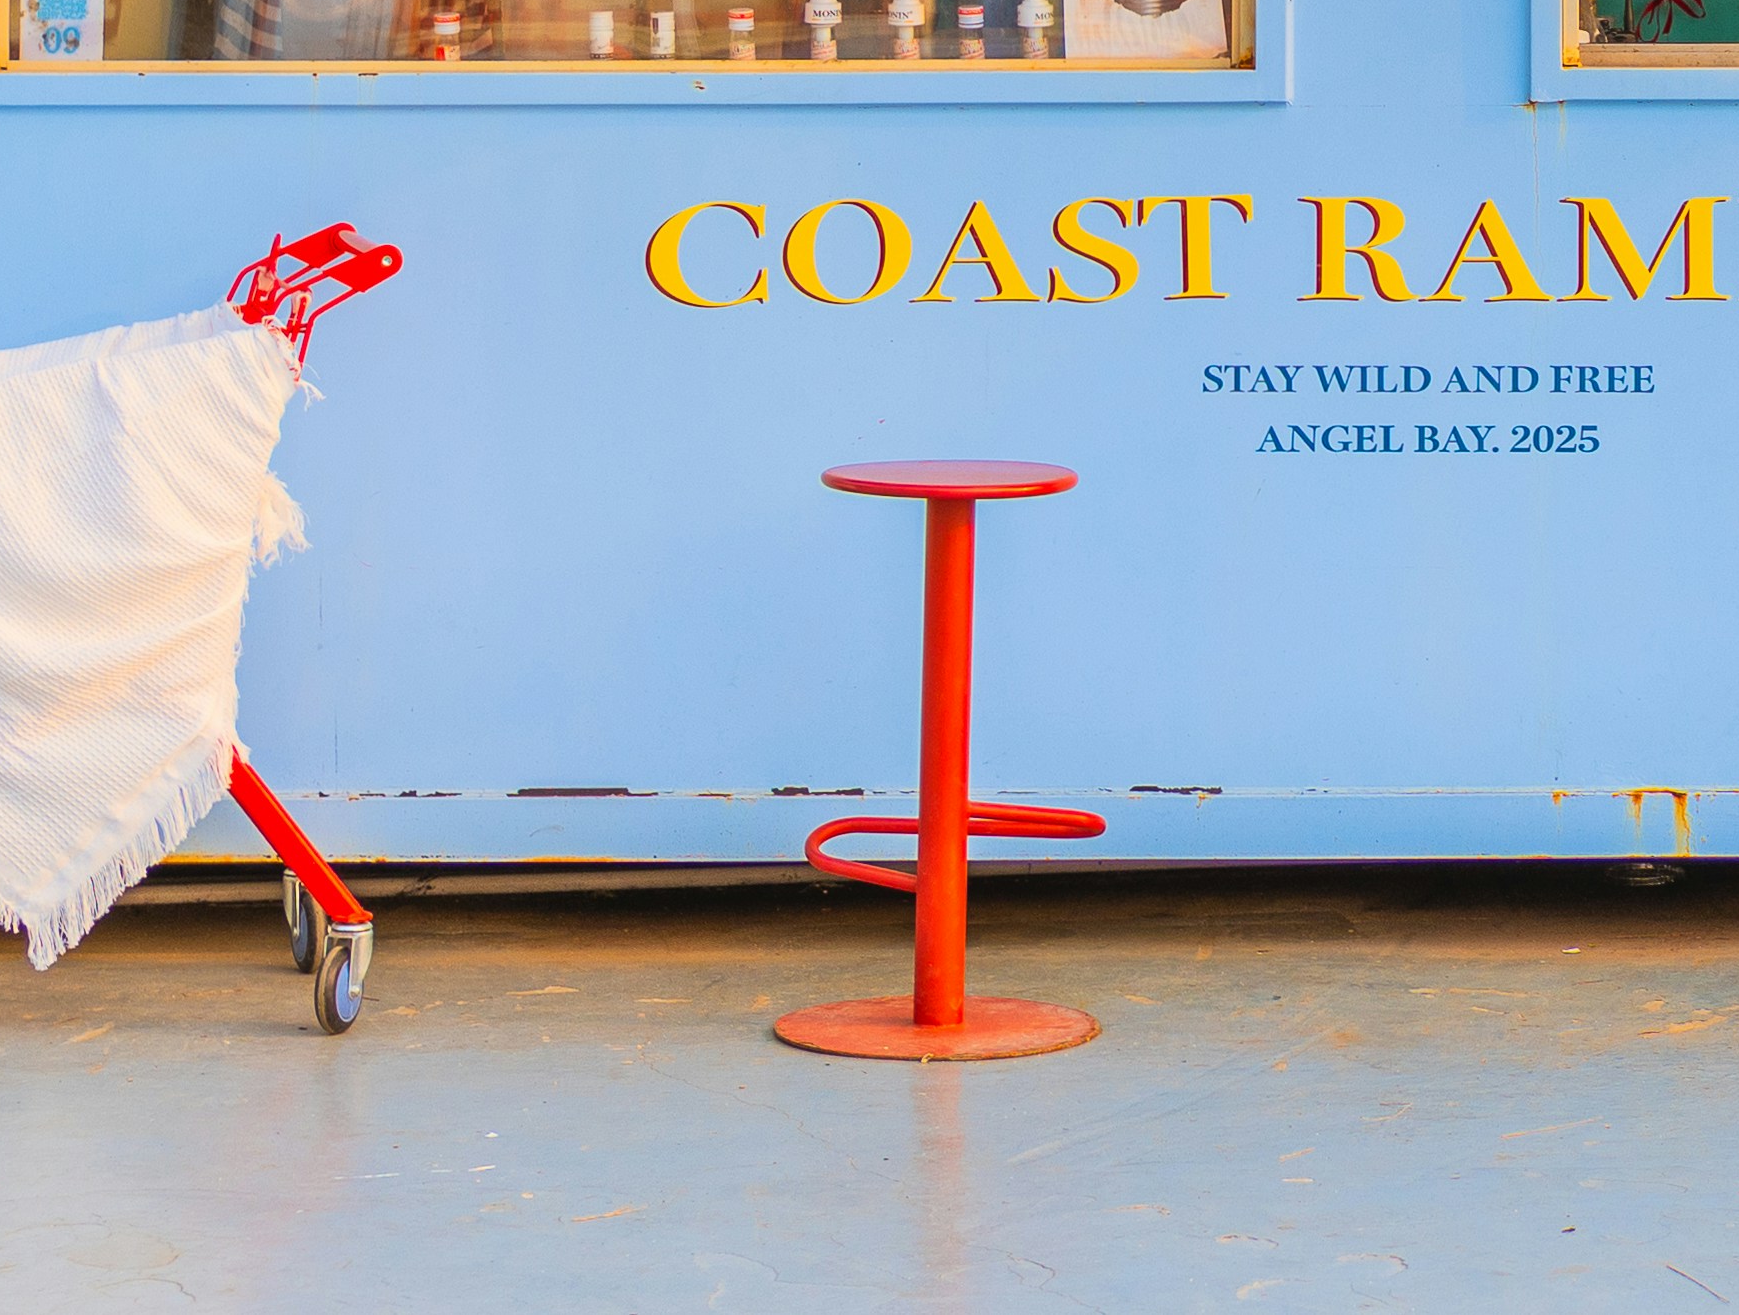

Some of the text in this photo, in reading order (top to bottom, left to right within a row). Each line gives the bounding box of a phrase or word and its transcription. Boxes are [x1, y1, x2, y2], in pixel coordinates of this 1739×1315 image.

[644, 193, 1254, 309] COAST
[1201, 363, 1655, 393] STAY WILD AND FREE
[1254, 423, 1600, 453] ANGEL BAY. 2025
